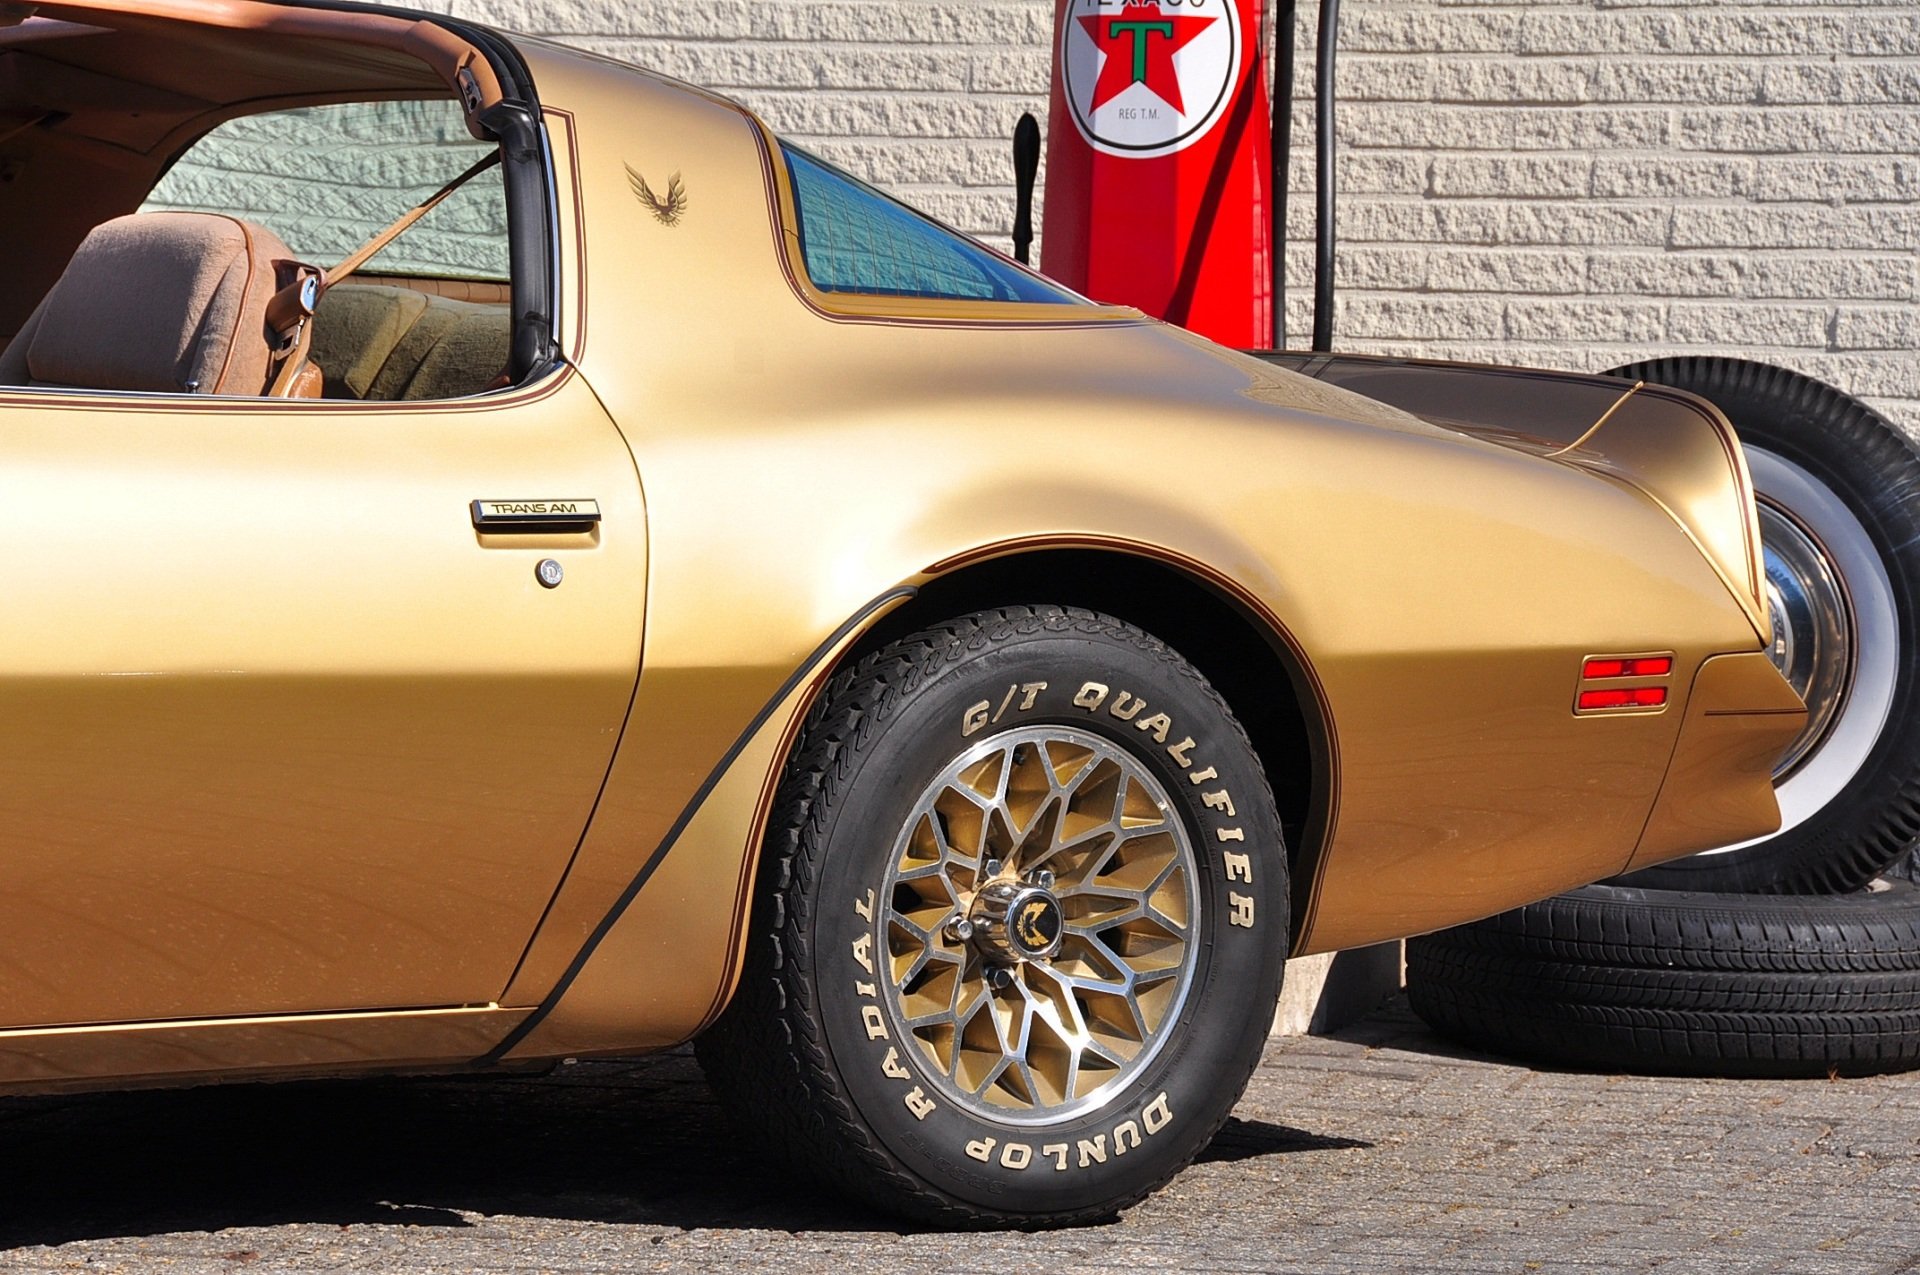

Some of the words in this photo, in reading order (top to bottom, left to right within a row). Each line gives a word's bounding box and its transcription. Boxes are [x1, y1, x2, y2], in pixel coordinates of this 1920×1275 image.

[1109, 21, 1173, 84] T
[1119, 108, 1137, 120] REG
[491, 503, 547, 514] TRANS
[549, 503, 577, 514] AM
[962, 681, 1048, 737] G/T
[1073, 681, 1255, 928] QUALIFIER
[852, 888, 937, 1121] RADIAL
[965, 1091, 1173, 1170] DUNLOP
